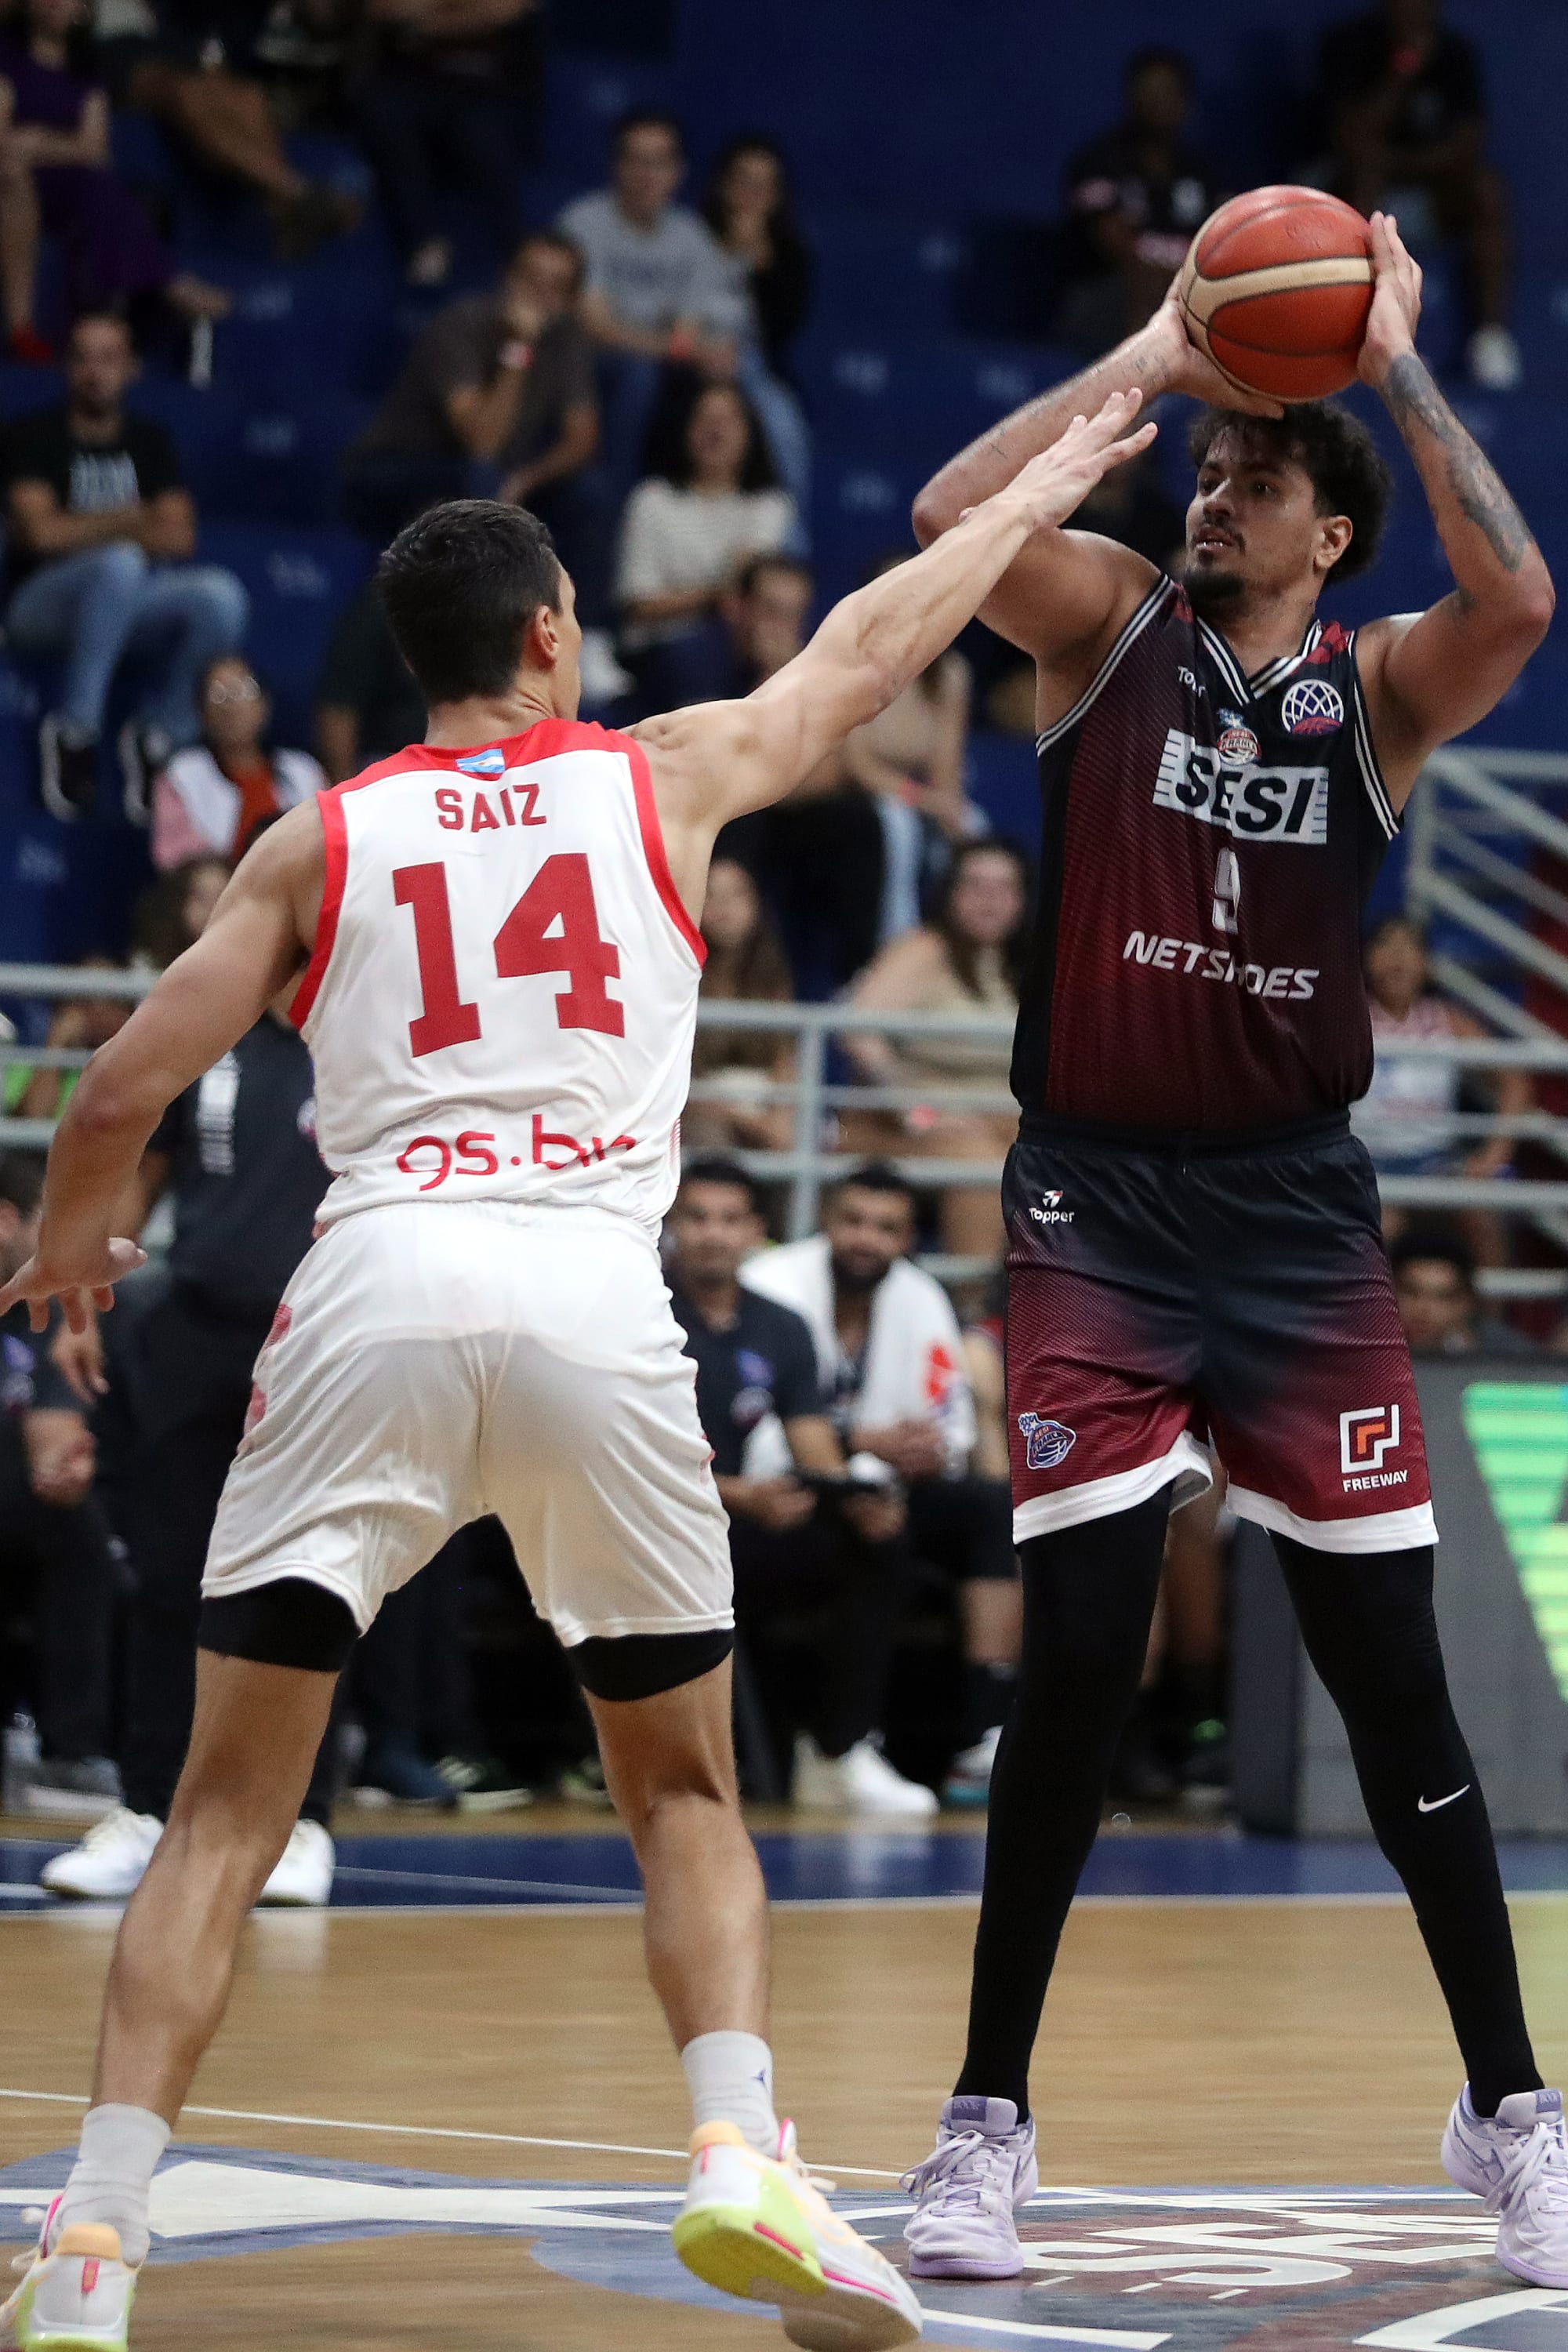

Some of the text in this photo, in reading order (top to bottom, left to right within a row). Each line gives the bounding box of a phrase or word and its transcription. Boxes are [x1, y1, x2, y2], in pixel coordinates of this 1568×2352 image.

[435, 783, 546, 833] SAIZ
[1175, 751, 1316, 833] SESI
[393, 853, 625, 1058] 14
[1123, 931, 1320, 1000] NETSHOES
[1028, 1207, 1075, 1225] Topper
[1342, 1469, 1408, 1493] FREEWAY
